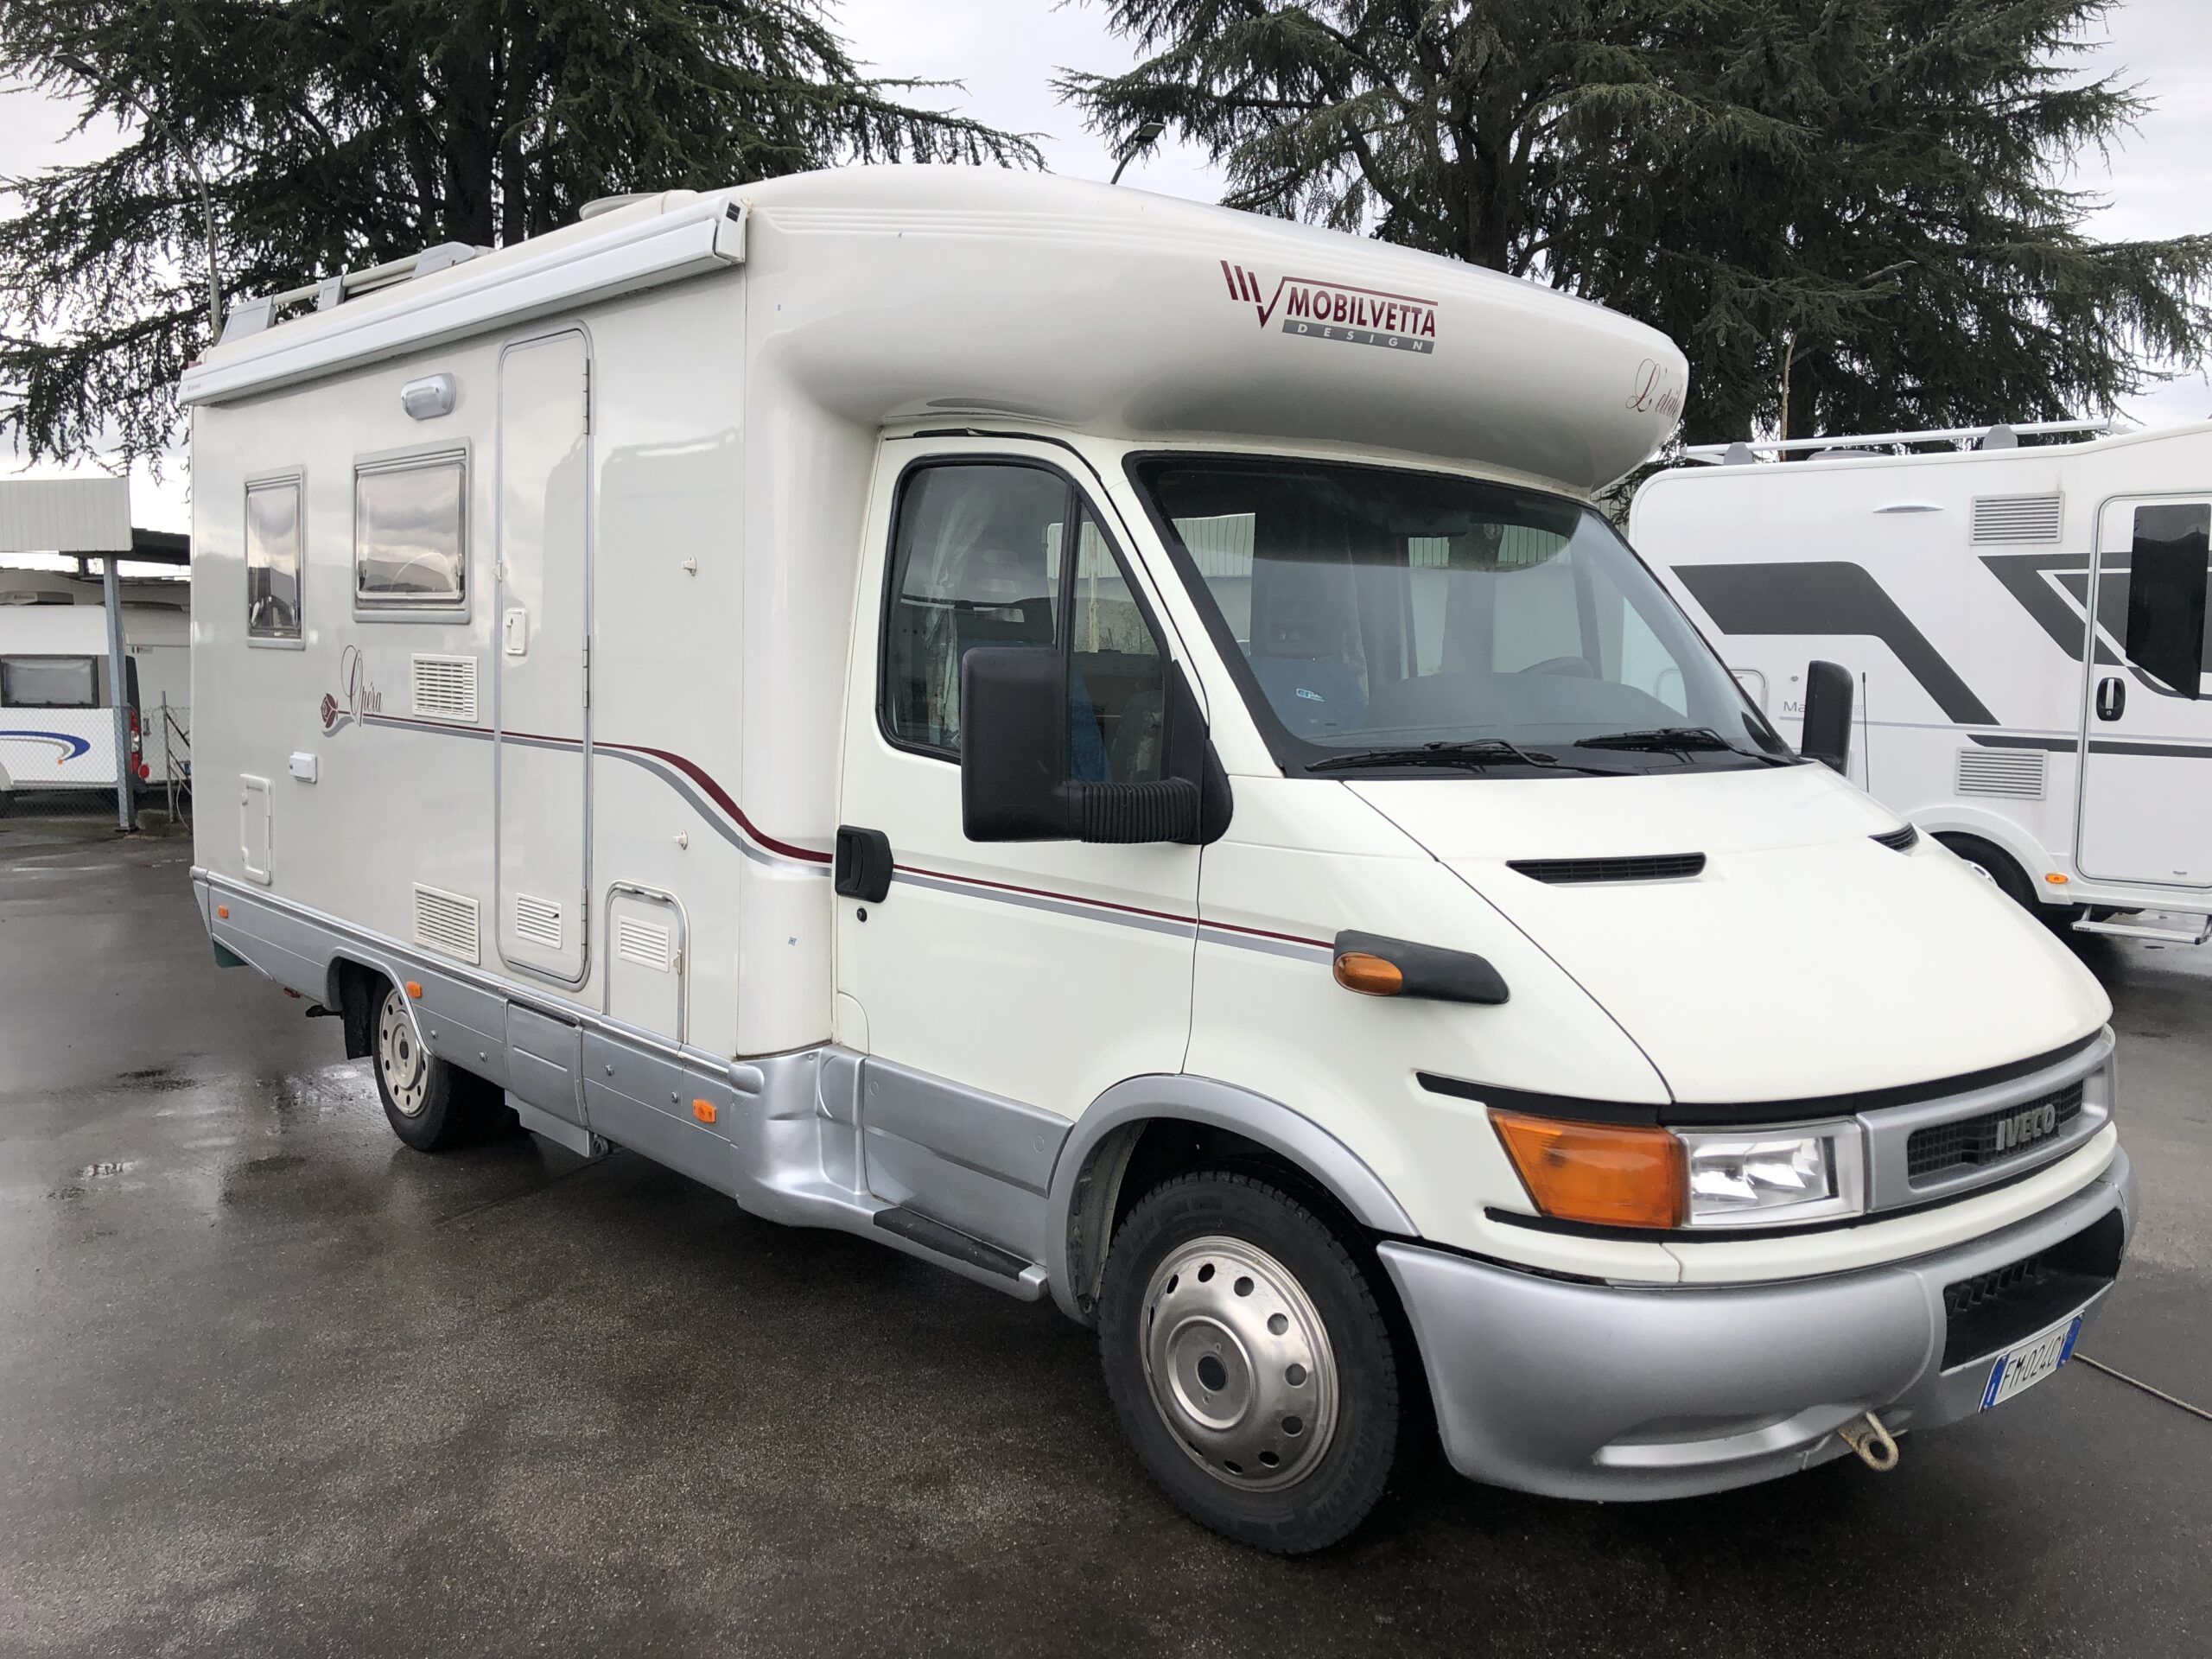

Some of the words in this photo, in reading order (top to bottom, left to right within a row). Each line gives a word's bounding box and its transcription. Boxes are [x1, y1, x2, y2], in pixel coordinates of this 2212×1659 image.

[1286, 286, 1436, 338] MOBILVETTA
[1297, 323, 1424, 351] DESIGN
[1996, 1103, 2056, 1151] IVECO
